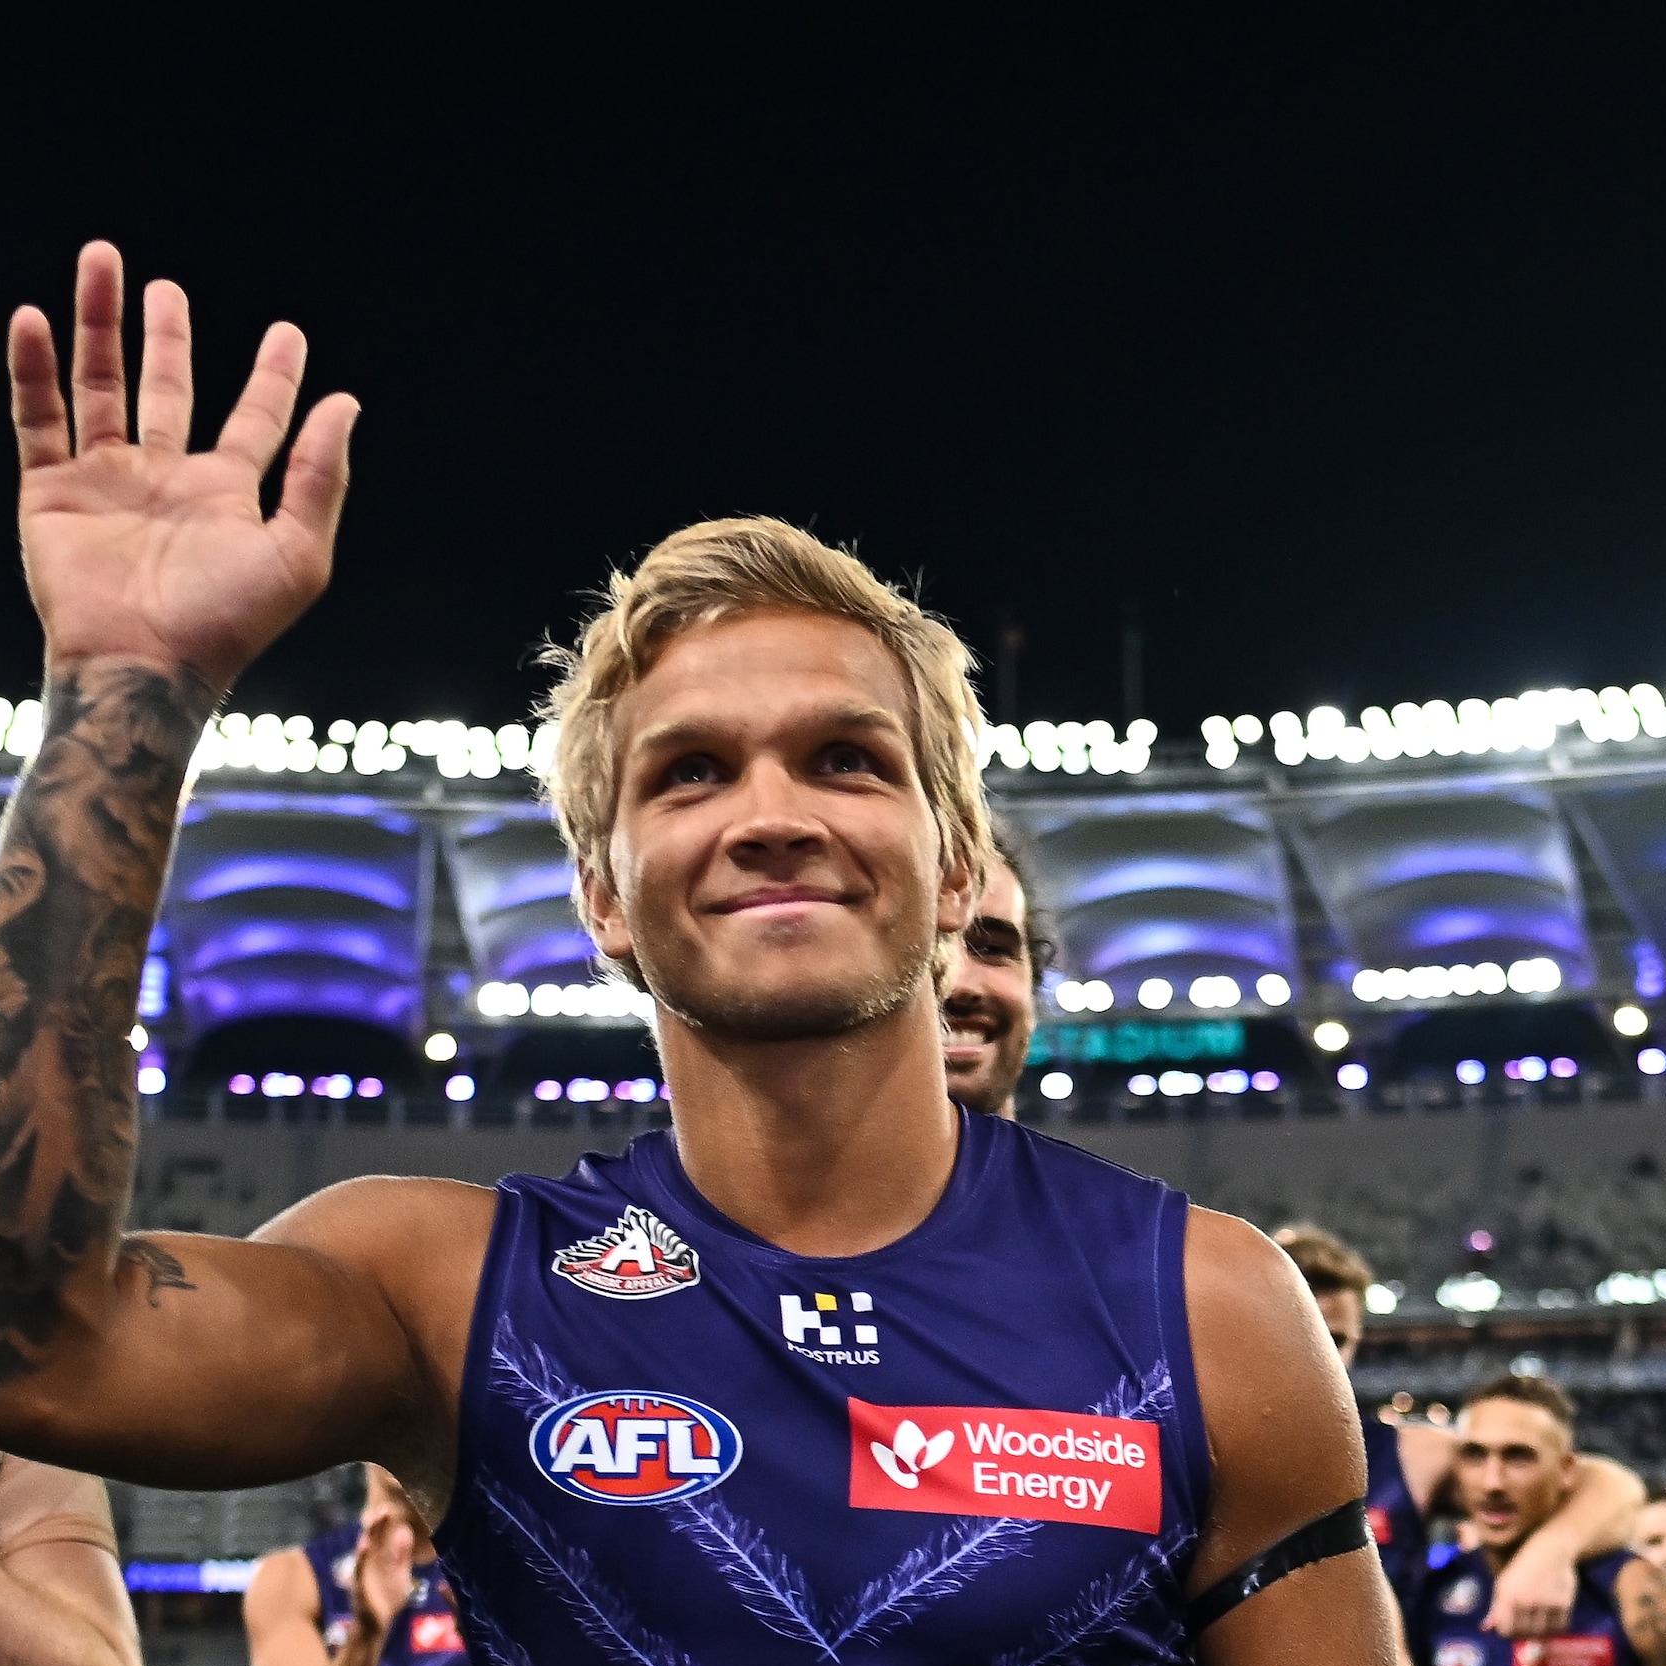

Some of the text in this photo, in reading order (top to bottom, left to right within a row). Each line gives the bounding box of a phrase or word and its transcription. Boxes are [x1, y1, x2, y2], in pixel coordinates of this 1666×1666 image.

[550, 1418, 722, 1474] AFL
[962, 1421, 1146, 1469] Woodside
[972, 1462, 1112, 1511] Energy
